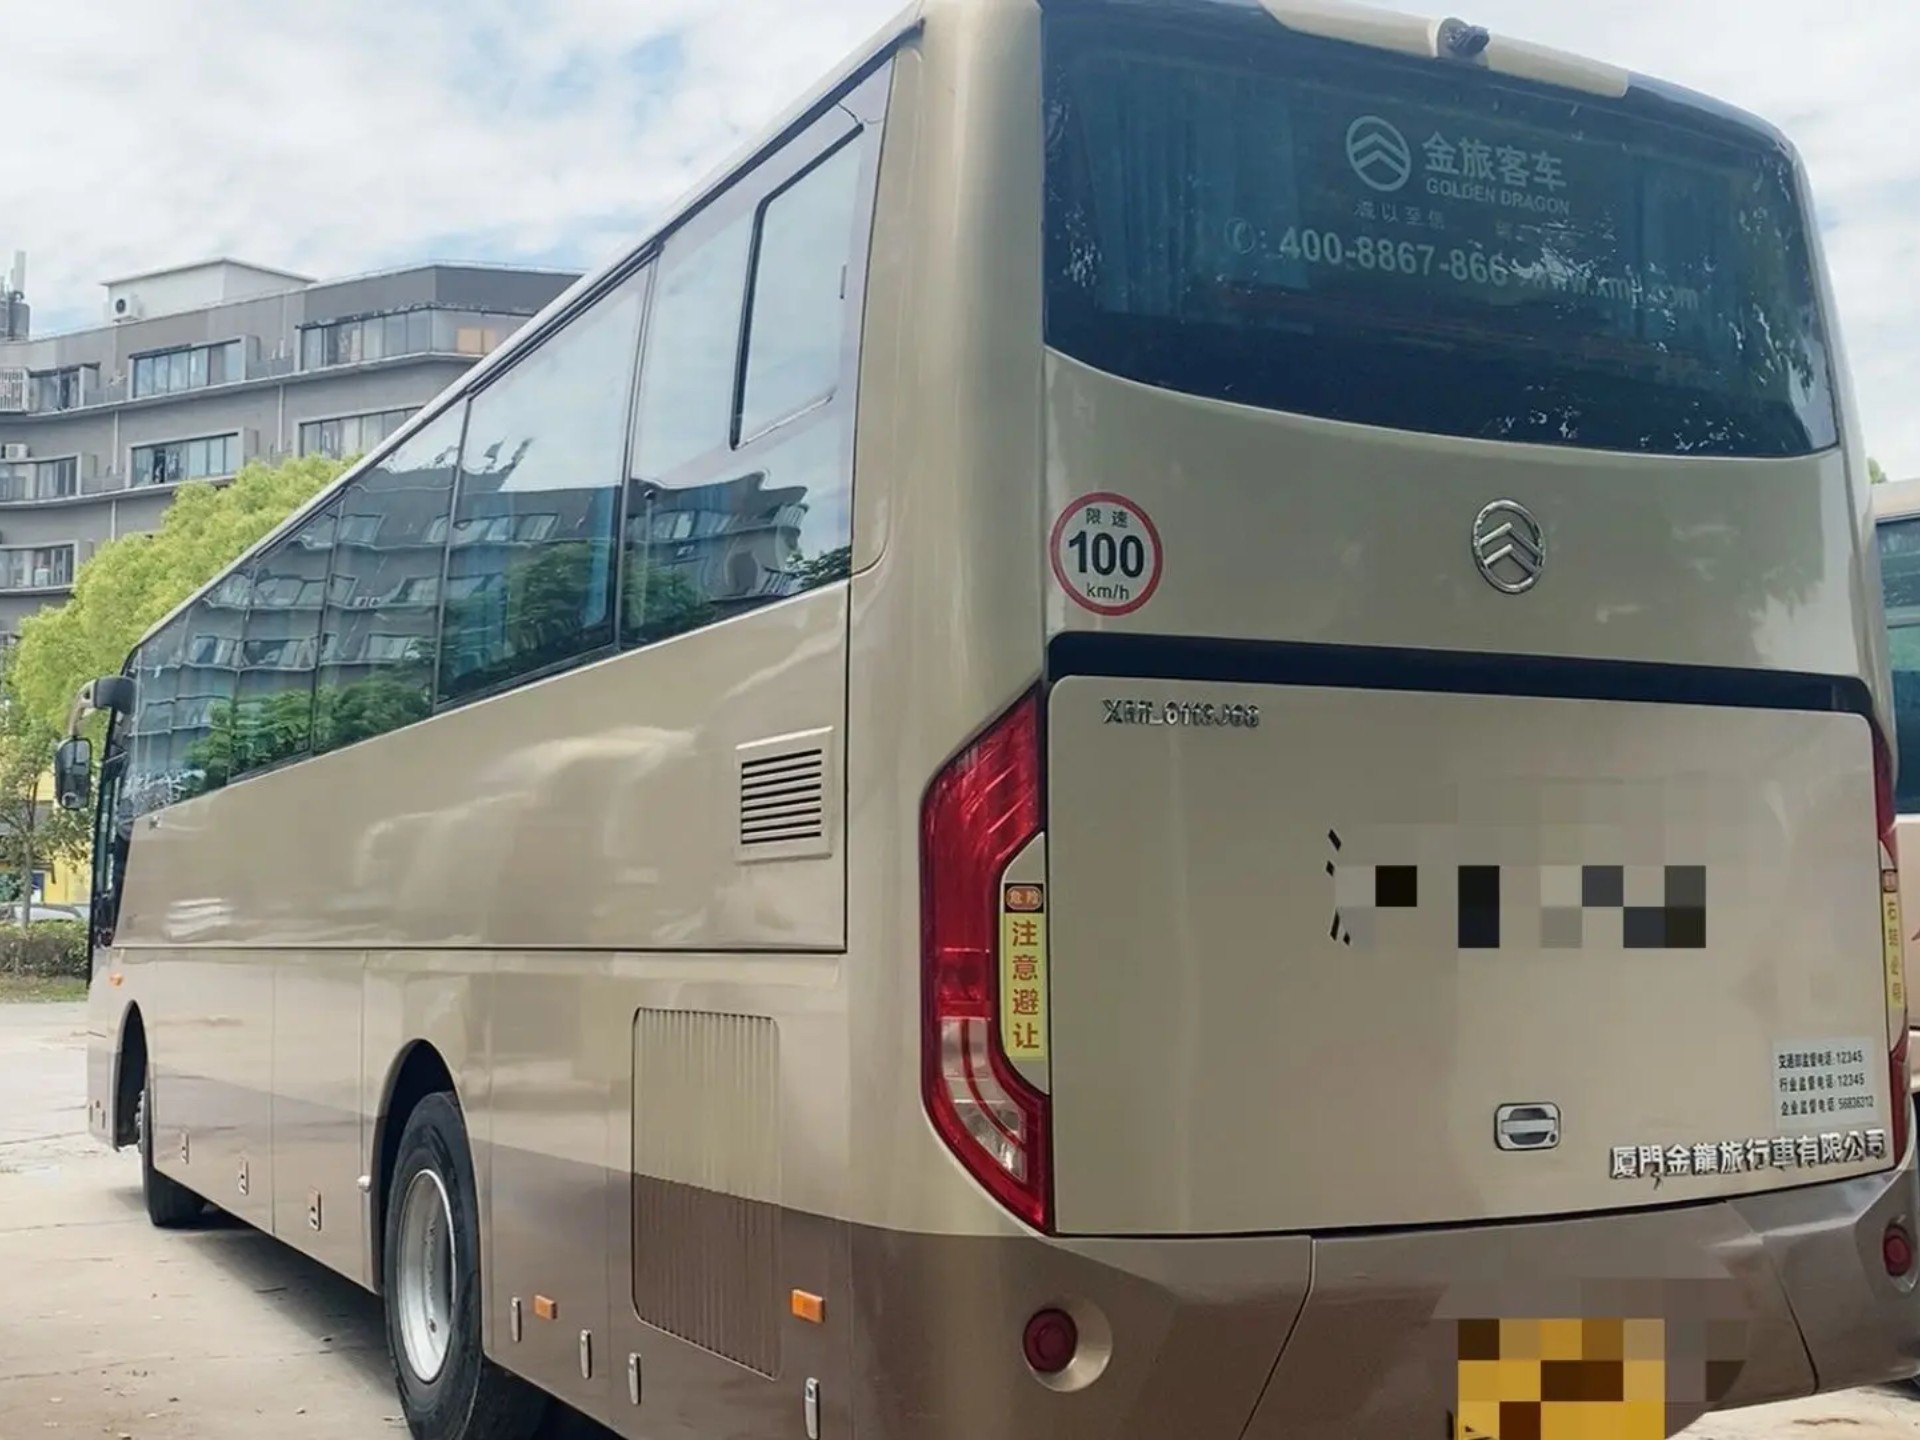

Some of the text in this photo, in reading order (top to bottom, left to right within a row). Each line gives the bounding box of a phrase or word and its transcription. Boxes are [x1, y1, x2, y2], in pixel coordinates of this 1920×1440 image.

[1422, 131, 1566, 191] 金旅客车
[1426, 177, 1571, 216] GOLDEN DRAGON
[1086, 507, 1128, 529] 限速
[1068, 530, 1144, 578] 100
[1086, 582, 1130, 600] km/h
[1012, 920, 1040, 1050] 注意避让
